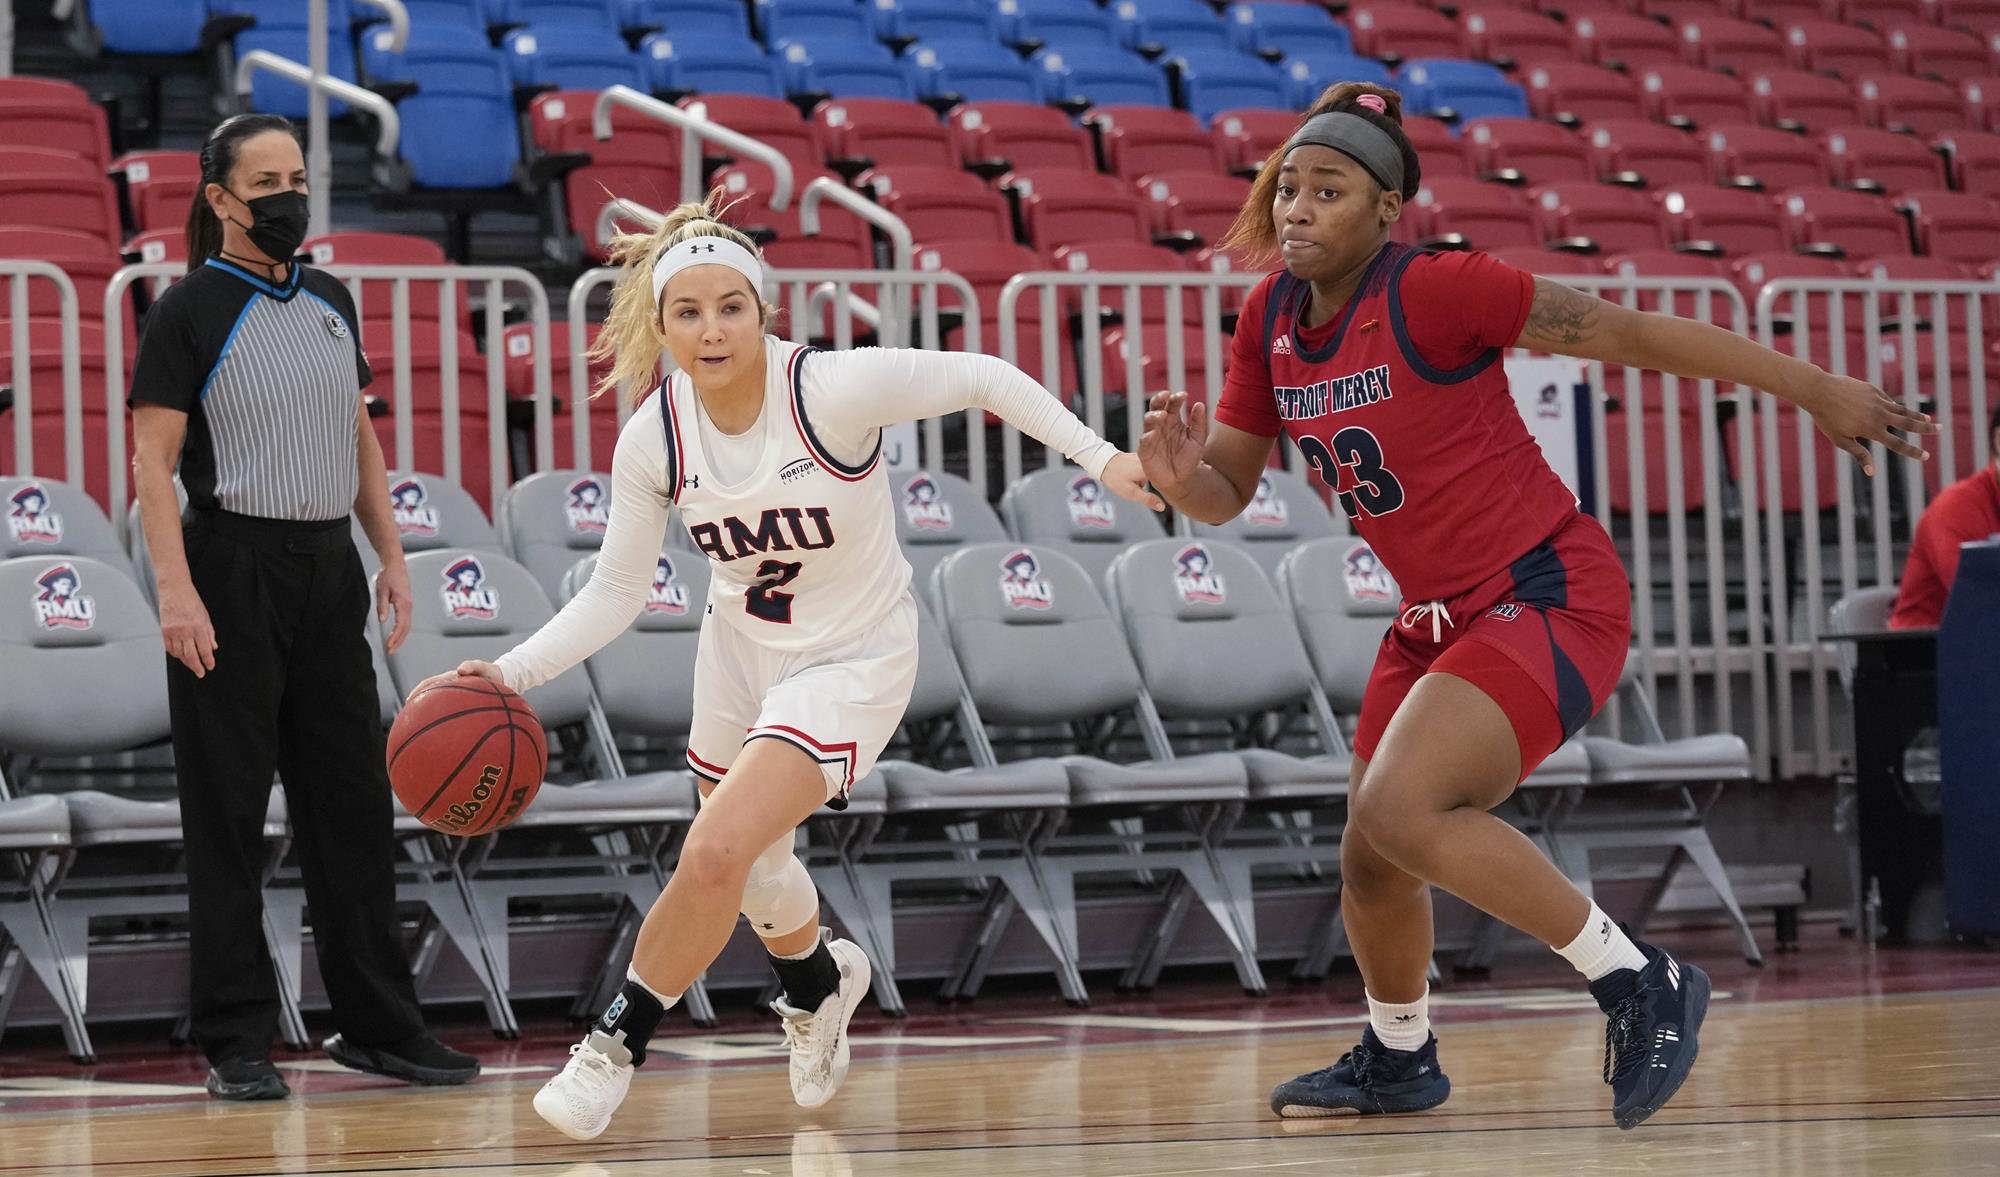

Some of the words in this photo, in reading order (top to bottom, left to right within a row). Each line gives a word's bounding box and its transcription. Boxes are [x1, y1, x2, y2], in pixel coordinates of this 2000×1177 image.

[1274, 381, 1329, 420] ETROIT
[1331, 364, 1393, 414] MERCY
[780, 461, 815, 480] HORIZON
[1298, 426, 1405, 520] 23
[9, 513, 62, 541] RMU
[690, 507, 835, 562] RMU
[648, 583, 688, 608] MU
[745, 559, 803, 624] 2
[1002, 580, 1051, 604] RMU
[1175, 574, 1224, 598] RMU
[36, 598, 94, 625] RMU
[445, 589, 497, 615] RMU
